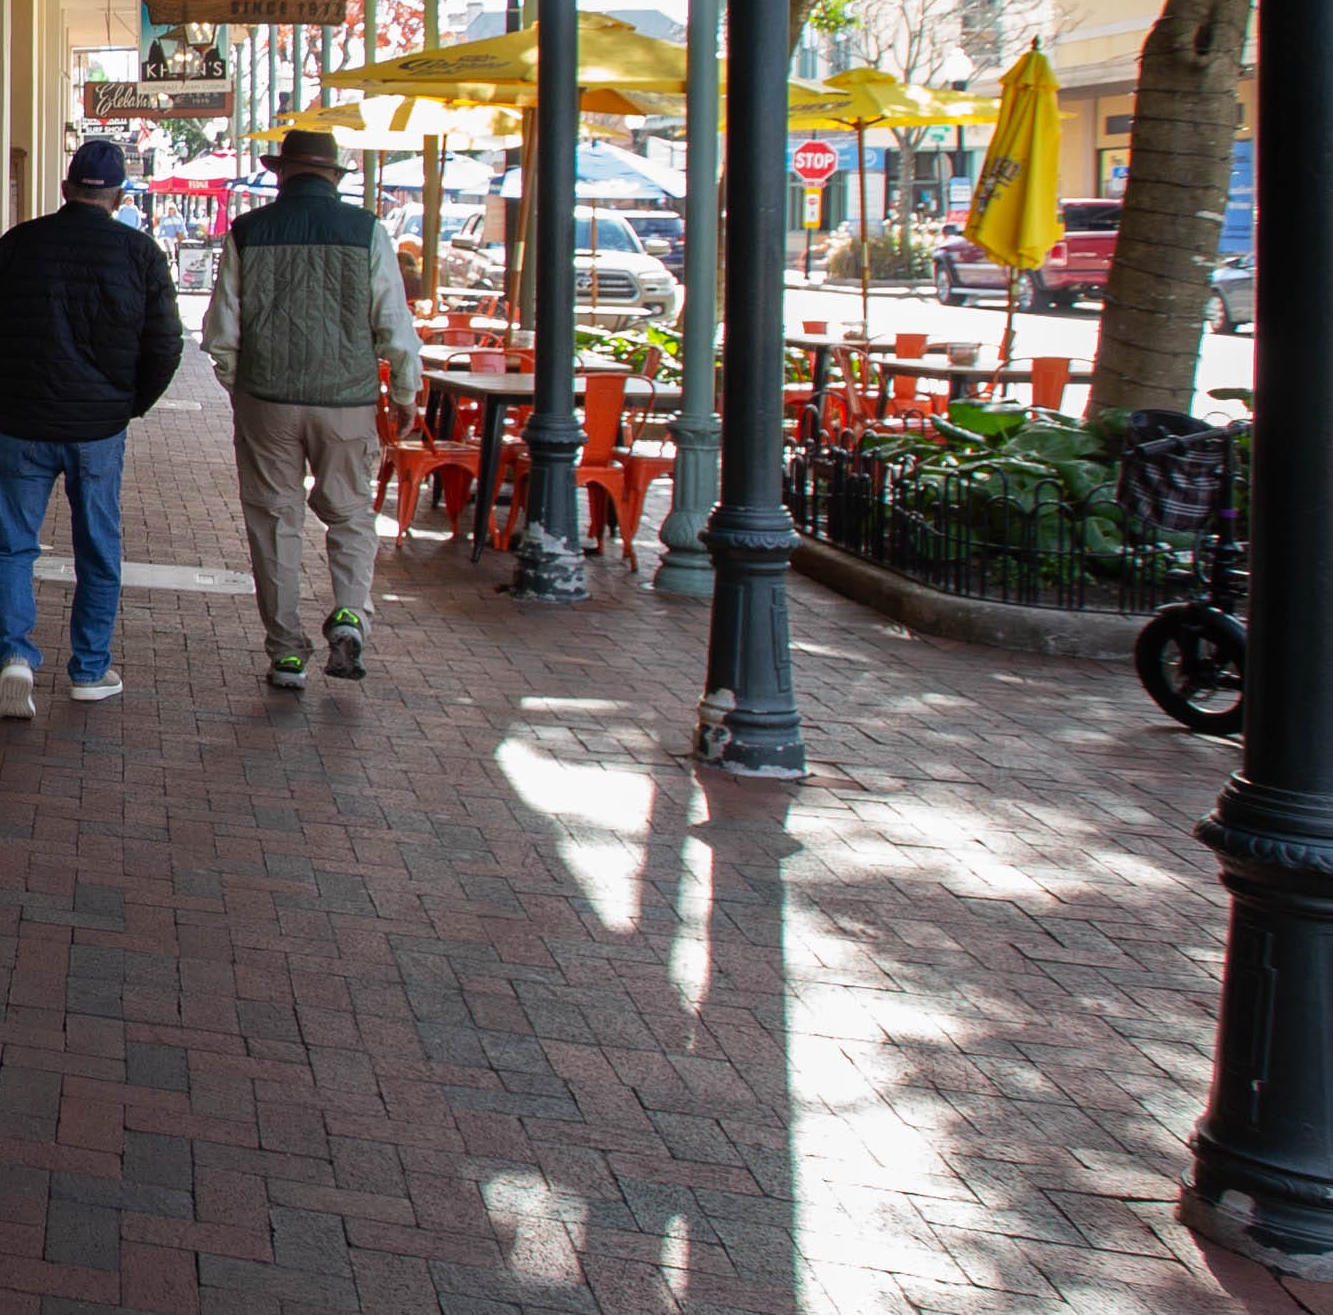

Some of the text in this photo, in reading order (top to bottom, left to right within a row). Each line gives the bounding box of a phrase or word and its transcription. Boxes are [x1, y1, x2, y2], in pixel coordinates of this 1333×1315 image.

[231, 0, 289, 16] SINCE
[146, 61, 224, 78] KHN'S
[105, 125, 125, 133] SHOP
[795, 151, 835, 170] STOP
